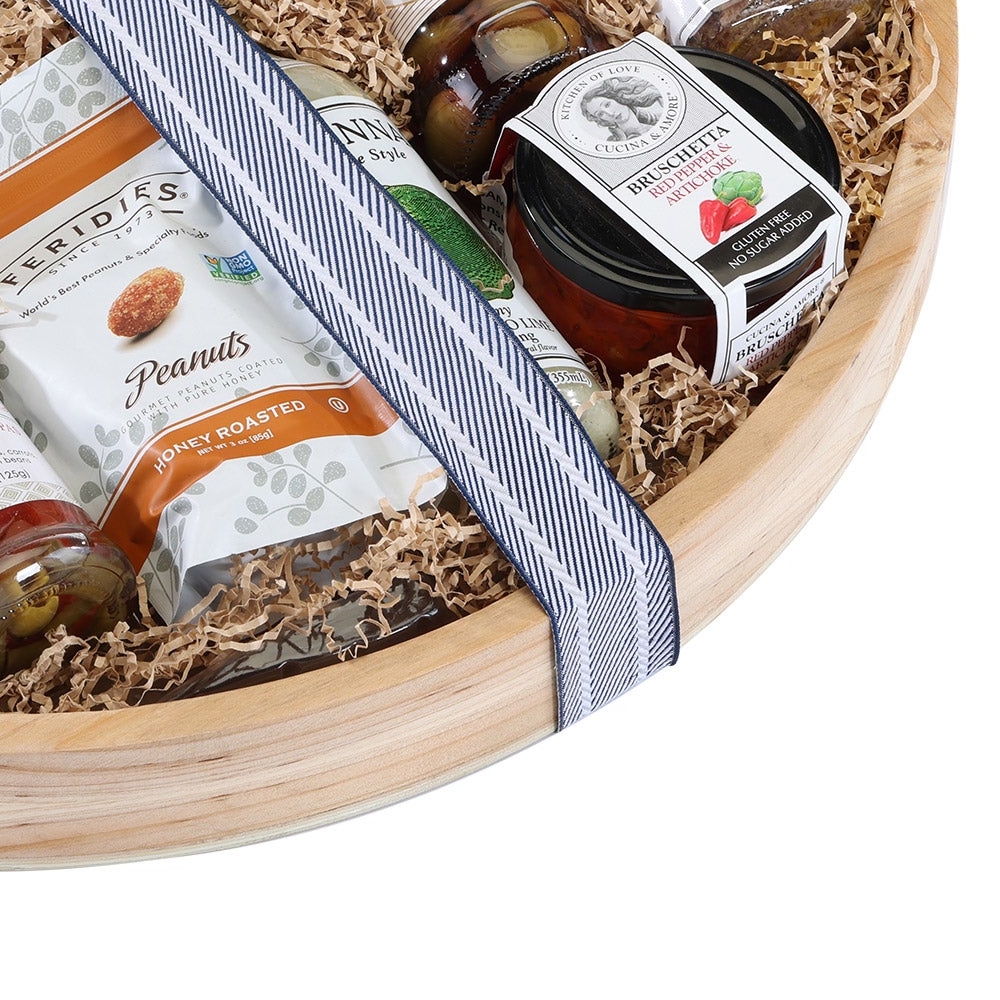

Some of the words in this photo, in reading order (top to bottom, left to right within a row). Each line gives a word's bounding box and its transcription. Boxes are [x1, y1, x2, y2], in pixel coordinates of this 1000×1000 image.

[561, 80, 589, 120] KITCHEN
[589, 71, 605, 83] OF
[608, 65, 641, 75] LOVE
[595, 139, 649, 153] CUCINA
[649, 132, 661, 141] &
[660, 95, 679, 132] AMORE
[368, 147, 407, 163] Style
[626, 125, 731, 196] BRUSCHETTA
[648, 174, 677, 200] RED
[676, 149, 720, 182] PEPPER
[717, 142, 734, 154] &
[665, 154, 738, 207] ARTICHOKE
[0, 181, 181, 288] FERIDIES
[49, 240, 101, 276] SINCE
[114, 210, 155, 241] 1973
[727, 251, 749, 271] NO
[747, 230, 783, 257] SUGAR
[780, 209, 814, 235] ADDED
[731, 222, 769, 253] GLUTEN
[765, 208, 792, 228] FREE
[18, 293, 58, 320] World's
[58, 279, 82, 297] Best
[81, 257, 124, 283] Peanuts
[136, 228, 179, 257] Specialty
[745, 316, 784, 343] CUCINA
[121, 394, 172, 435] GOURMET
[178, 371, 234, 397] PEANUTS
[238, 357, 284, 374] COATED
[124, 331, 252, 410] Peanuts
[149, 402, 179, 422] WITH
[185, 385, 216, 403] PURE
[221, 370, 263, 389] HONEY
[154, 433, 212, 475] HONEY
[215, 400, 307, 440] ROASTED
[196, 445, 214, 457] NET
